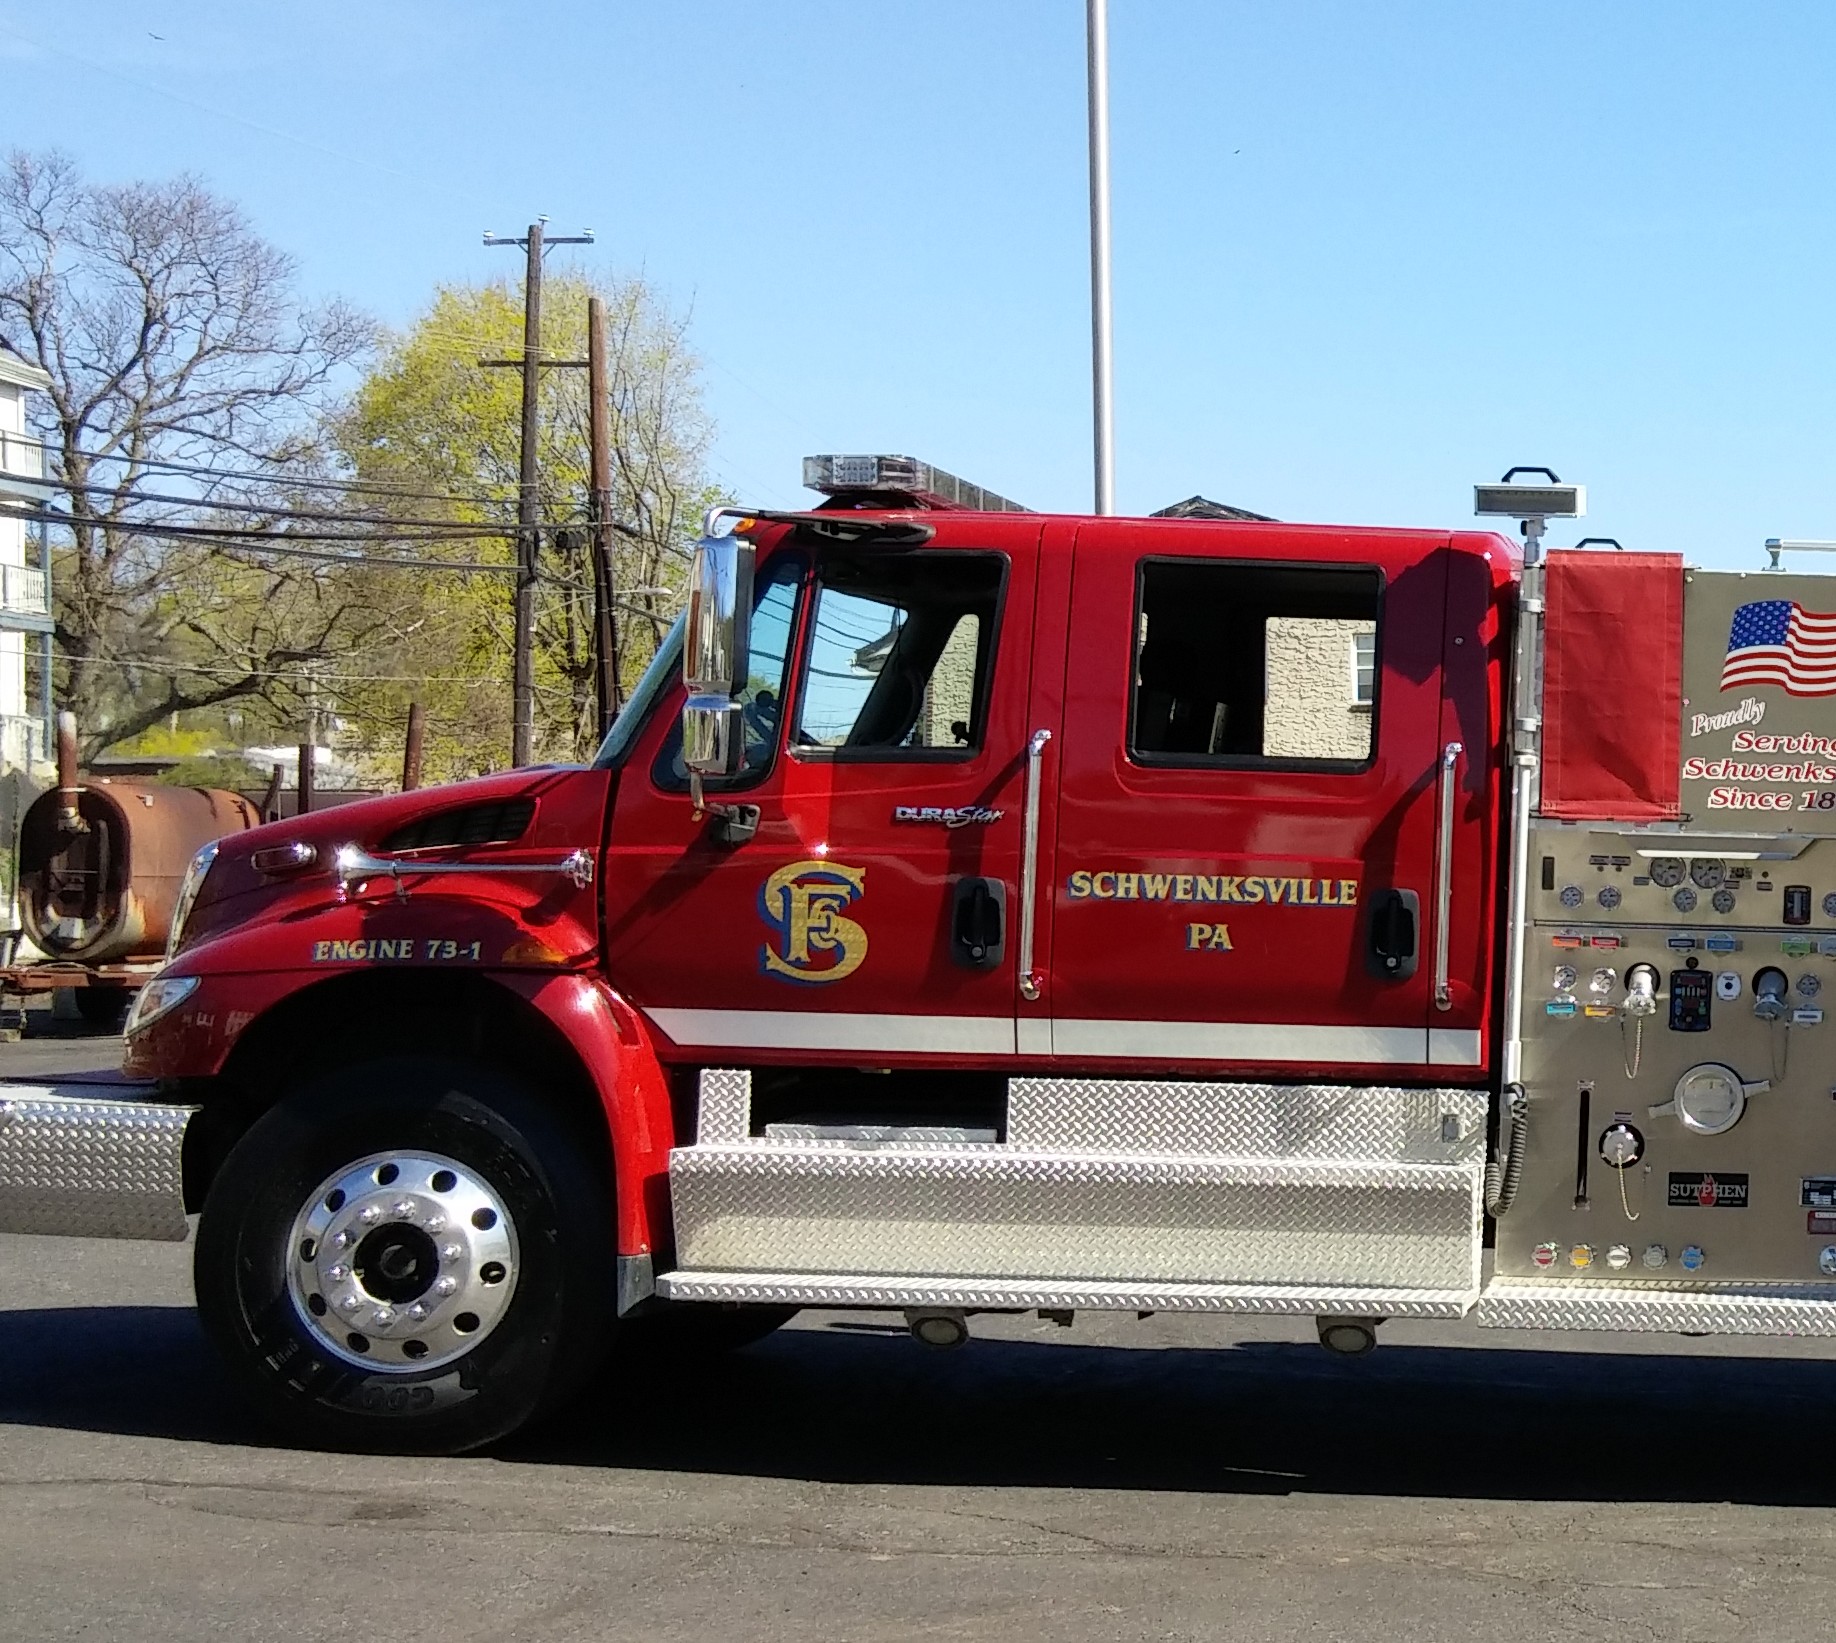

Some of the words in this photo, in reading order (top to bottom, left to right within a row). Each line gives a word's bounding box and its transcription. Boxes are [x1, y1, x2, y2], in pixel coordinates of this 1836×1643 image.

[1690, 697, 1766, 737] Proudly
[1708, 786, 1793, 811] Since
[1068, 871, 1358, 906] SCHWENKSVILLE
[1185, 922, 1234, 951] PA
[313, 939, 415, 962] ENGINE
[426, 939, 482, 961] 73-1
[1669, 1183, 1748, 1198] SUTPHEN
